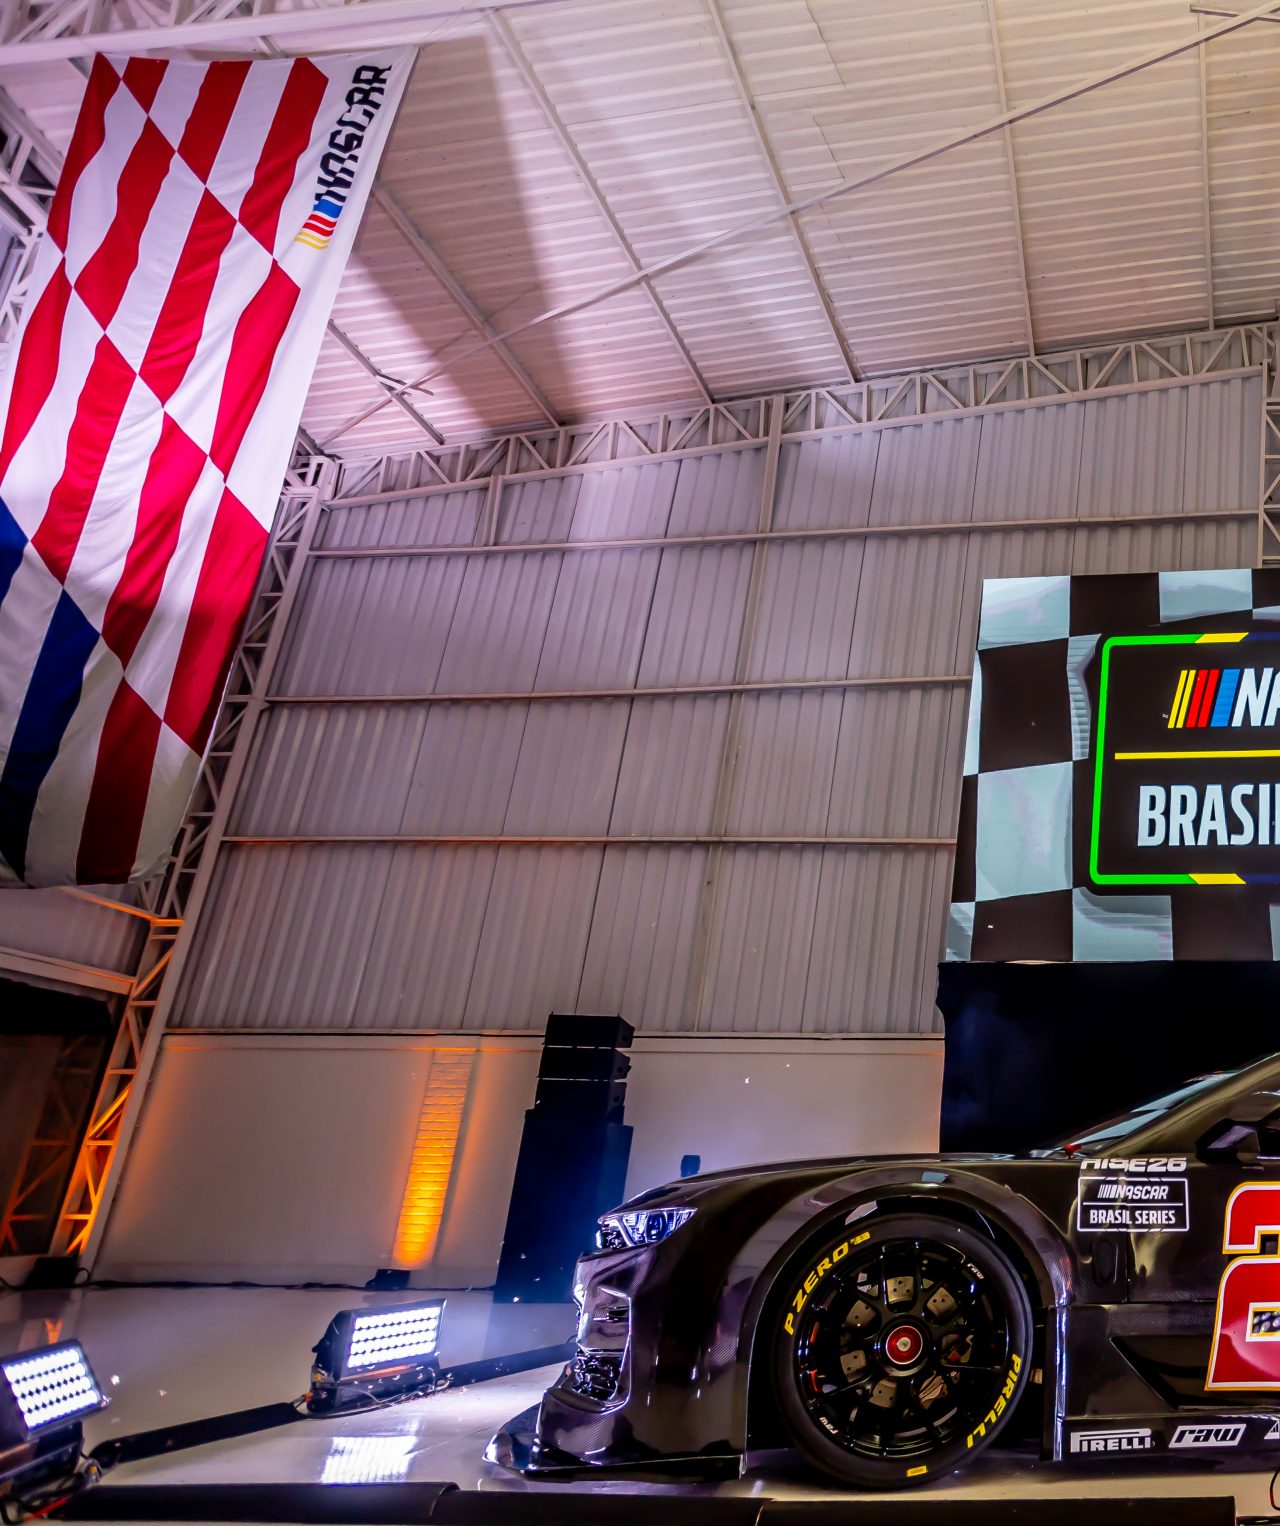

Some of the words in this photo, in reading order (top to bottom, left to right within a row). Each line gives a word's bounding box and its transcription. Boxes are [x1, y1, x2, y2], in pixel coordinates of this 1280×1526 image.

[314, 65, 392, 203] NASCAR
[1089, 1209, 1132, 1224] BRASIL
[1135, 1209, 1176, 1225] SERIES
[1115, 1184, 1169, 1200] NASCAR
[784, 1312, 794, 1336] P
[792, 1241, 849, 1313] ZERO
[966, 1353, 1021, 1449] PIRELLI
[1070, 1428, 1152, 1453] PIRELLI
